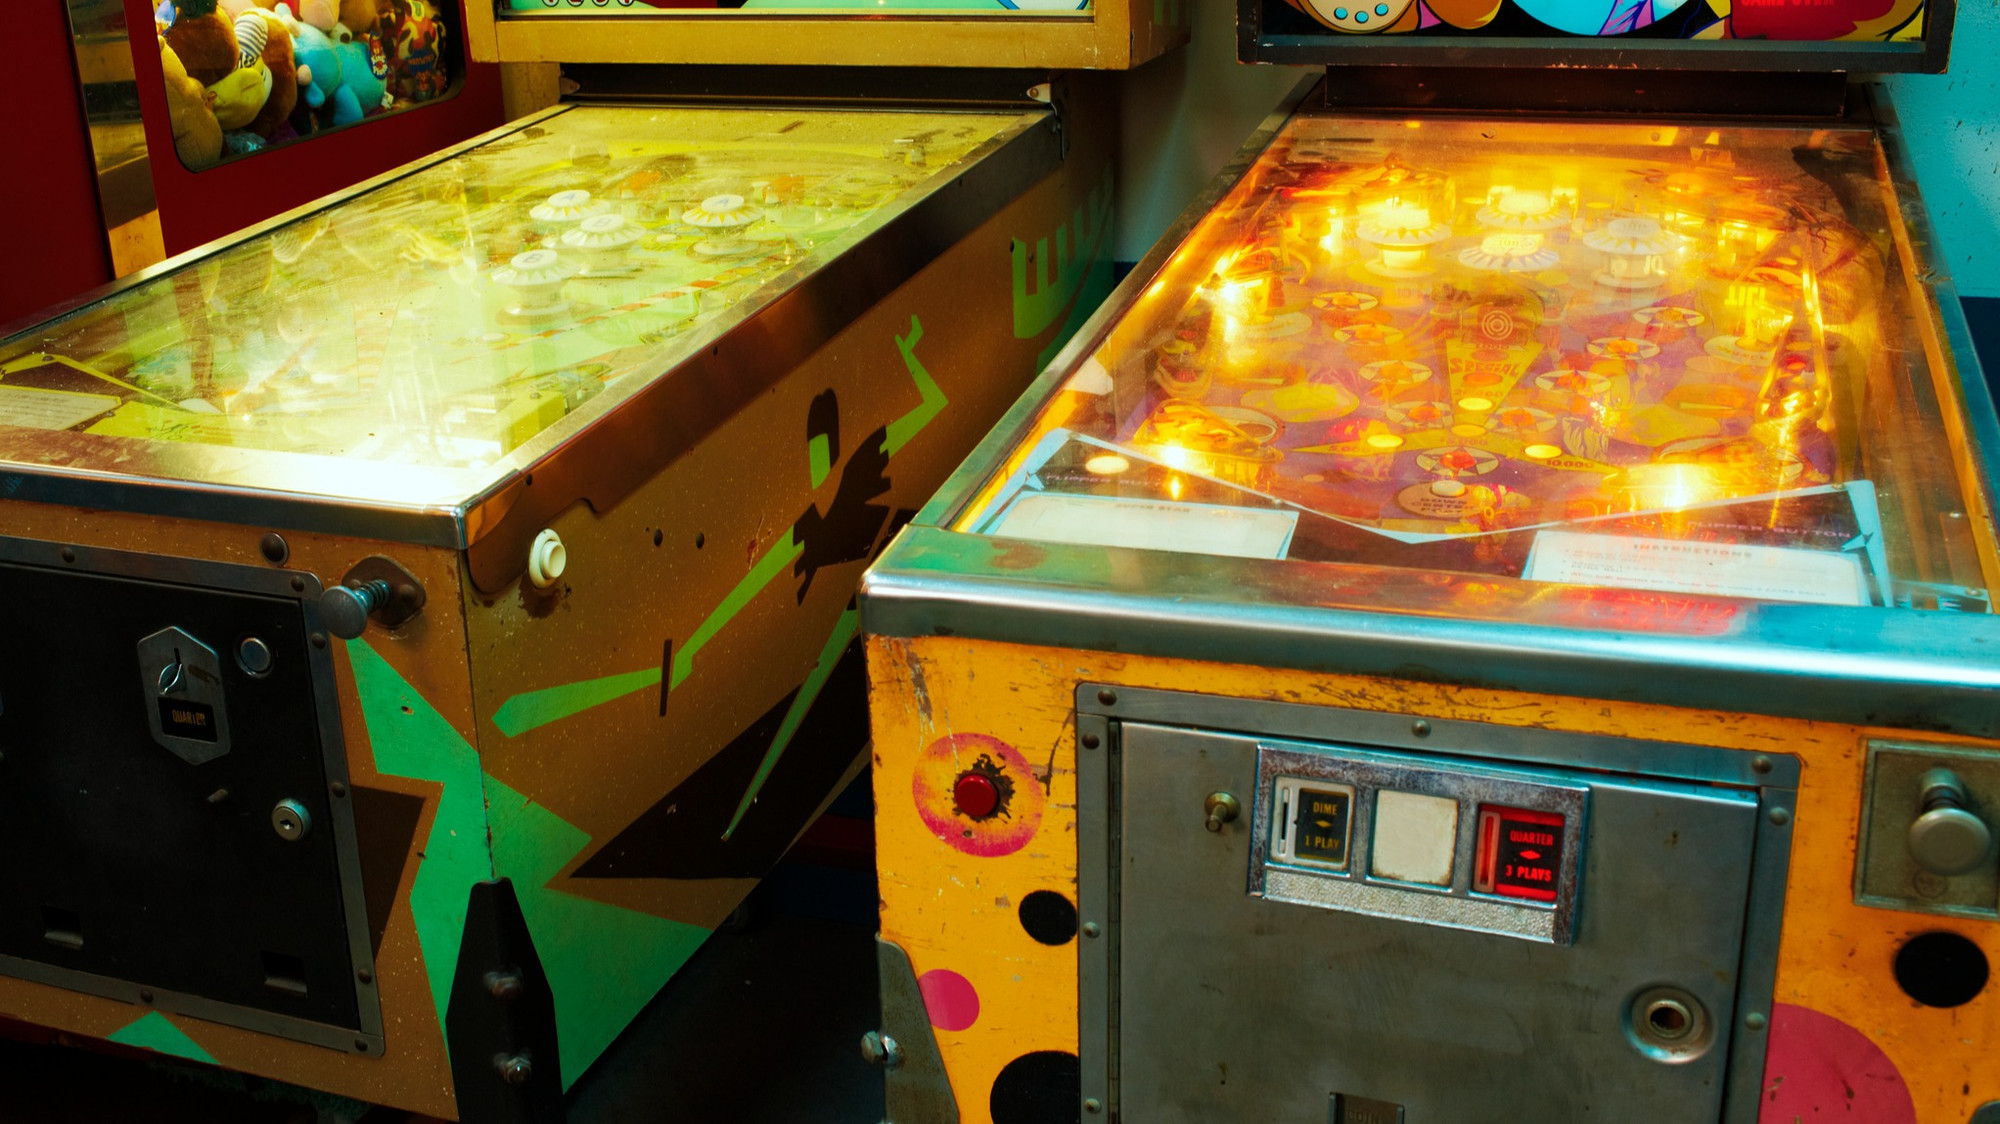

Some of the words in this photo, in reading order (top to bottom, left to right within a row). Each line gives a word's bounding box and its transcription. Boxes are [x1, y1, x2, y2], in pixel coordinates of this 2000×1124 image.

[1449, 357, 1520, 379] SPECIAL
[1687, 520, 1763, 531] FLIPPER
[1772, 527, 1851, 538] BUTTON
[1312, 801, 1338, 815] DIME
[1304, 835, 1310, 847] 1
[1314, 836, 1339, 849] PLAY
[1510, 829, 1554, 846] QUARTER
[1505, 864, 1512, 877] 3
[1517, 865, 1552, 882] PLAYS
